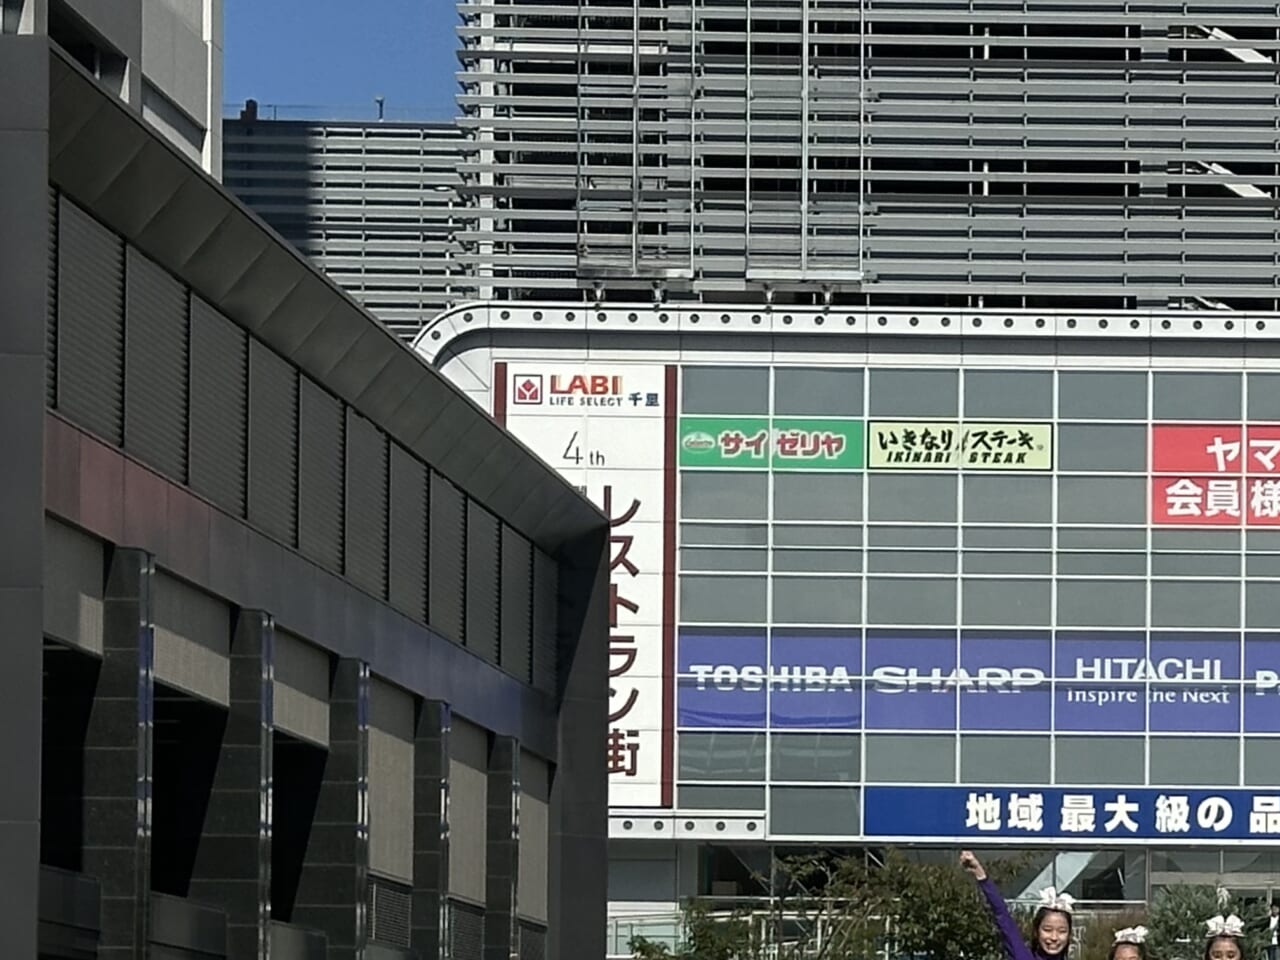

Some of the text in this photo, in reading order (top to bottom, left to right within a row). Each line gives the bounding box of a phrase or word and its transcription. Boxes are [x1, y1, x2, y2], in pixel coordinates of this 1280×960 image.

[550, 375, 621, 395] LABI
[550, 397, 623, 406] LIFE SELECT
[628, 392, 660, 407] 千里
[720, 430, 845, 459] サイゼリヤ
[887, 452, 1027, 464] IKINARI STEAK
[604, 485, 641, 777] レストラン街
[689, 665, 854, 692] TOSHIBA
[871, 666, 1045, 693] SHARP
[1075, 658, 1222, 682] HITACHI
[1183, 686, 1230, 704] Next
